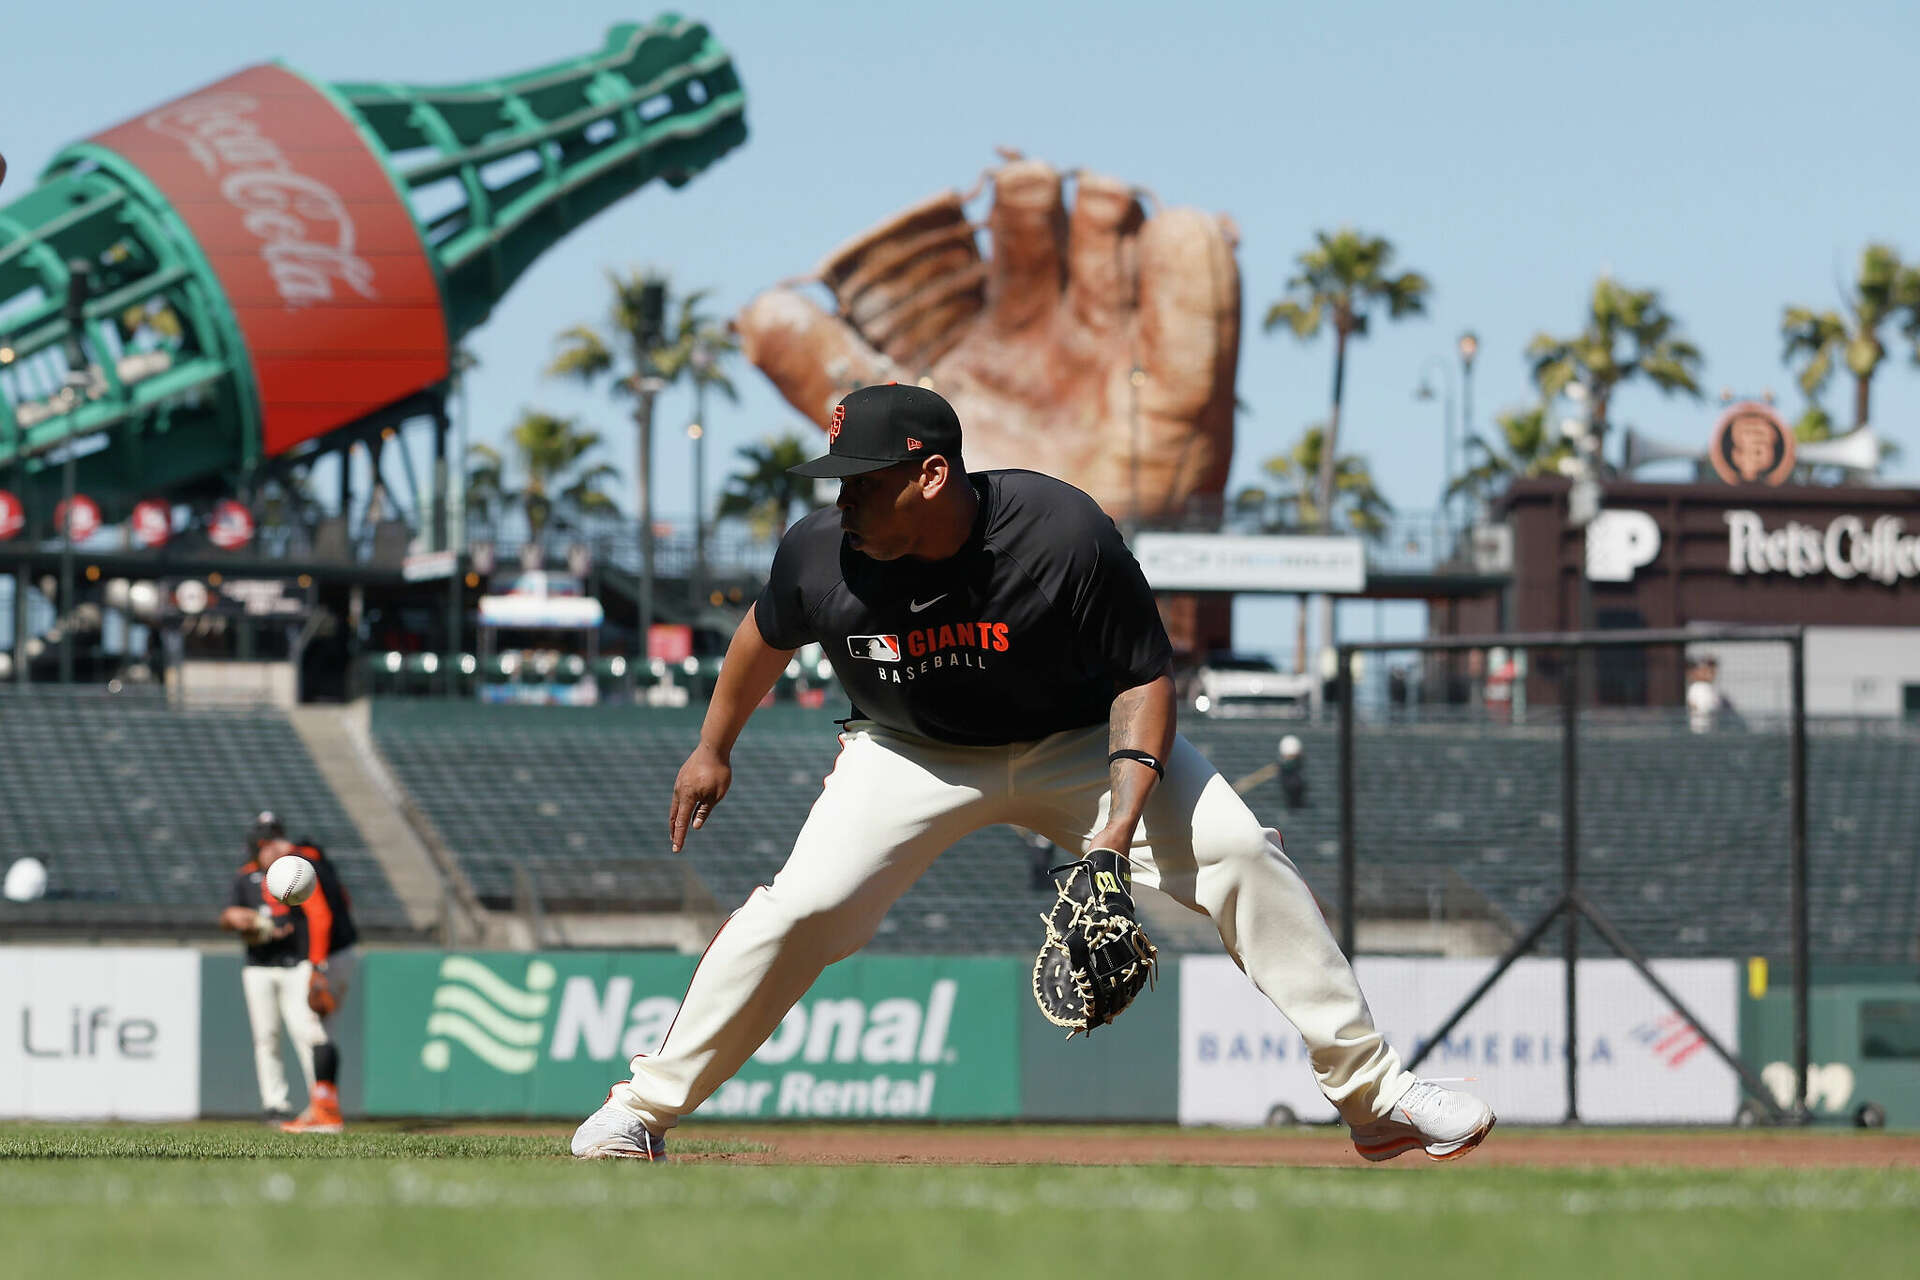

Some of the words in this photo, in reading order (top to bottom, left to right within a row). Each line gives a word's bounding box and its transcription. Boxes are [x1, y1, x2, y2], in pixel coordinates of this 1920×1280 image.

[907, 622, 1009, 657] GIANTS
[878, 652, 986, 683] BASEBALL
[22, 1005, 158, 1058] Life
[550, 976, 957, 1065] Naonal
[1198, 1034, 1310, 1062] BAN
[697, 1079, 772, 1116] ar
[775, 1071, 936, 1117] Rental
